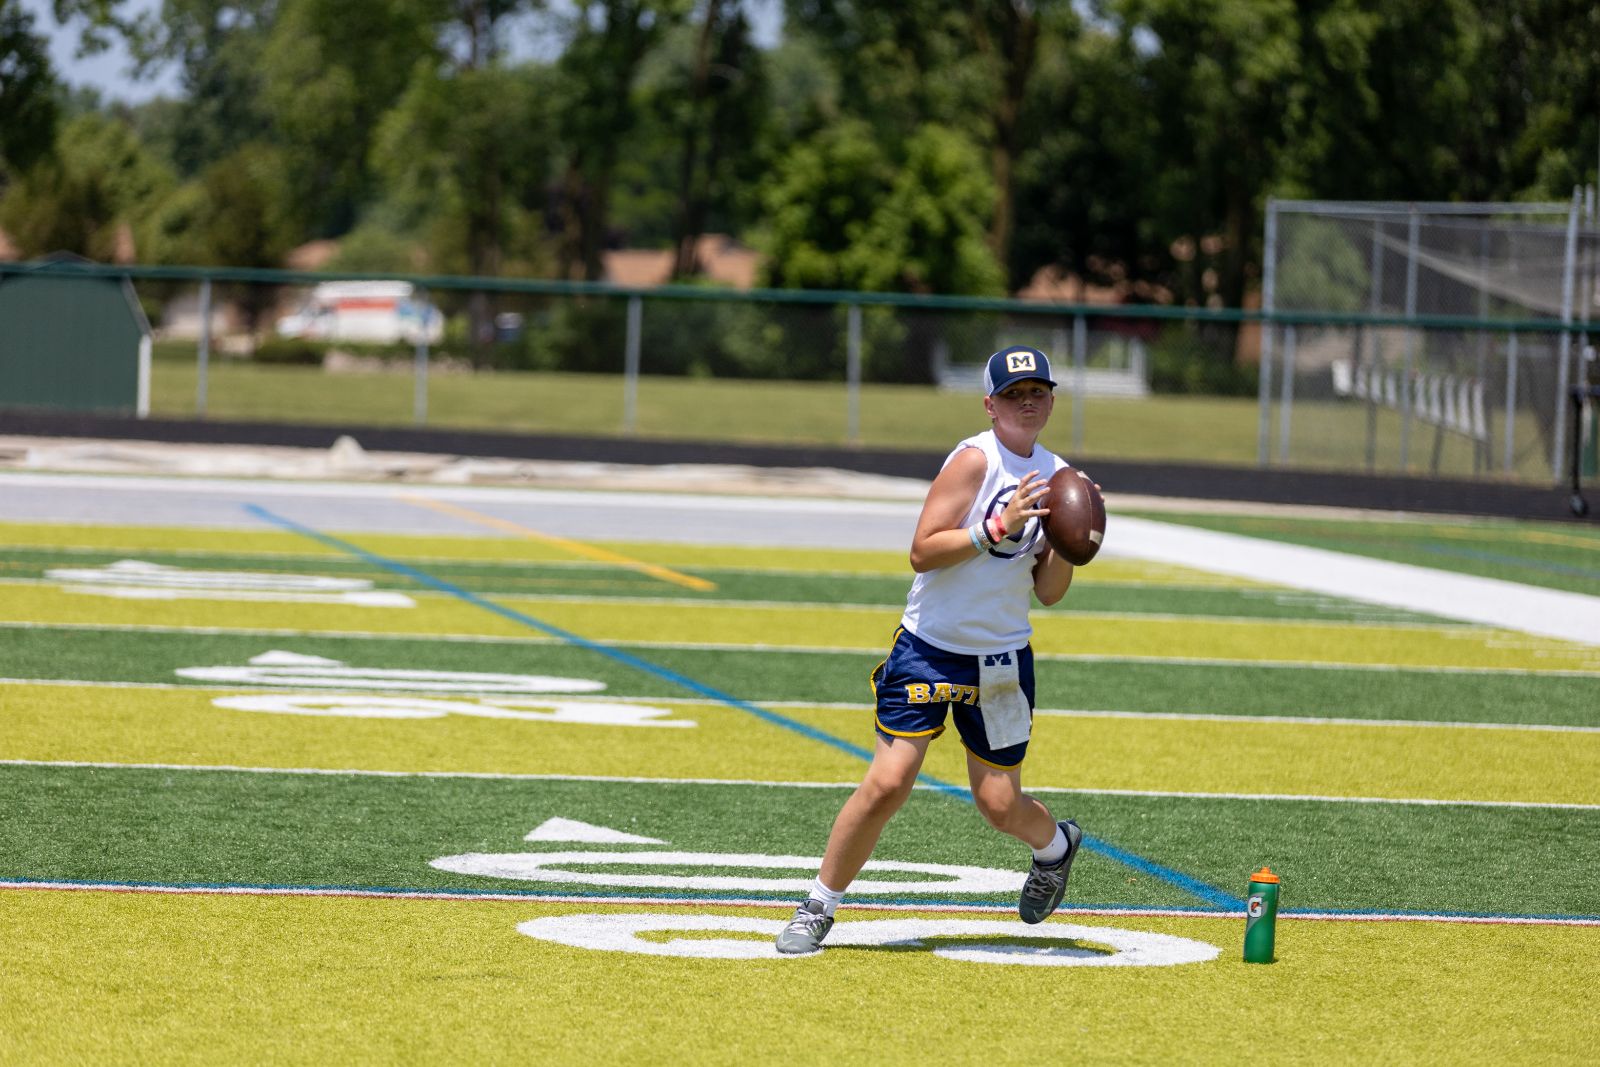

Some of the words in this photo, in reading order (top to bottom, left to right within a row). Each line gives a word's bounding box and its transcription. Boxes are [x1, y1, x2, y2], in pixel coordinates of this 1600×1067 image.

[1010, 355, 1032, 369] M
[905, 683, 980, 708] BATT
[1247, 896, 1262, 918] G
